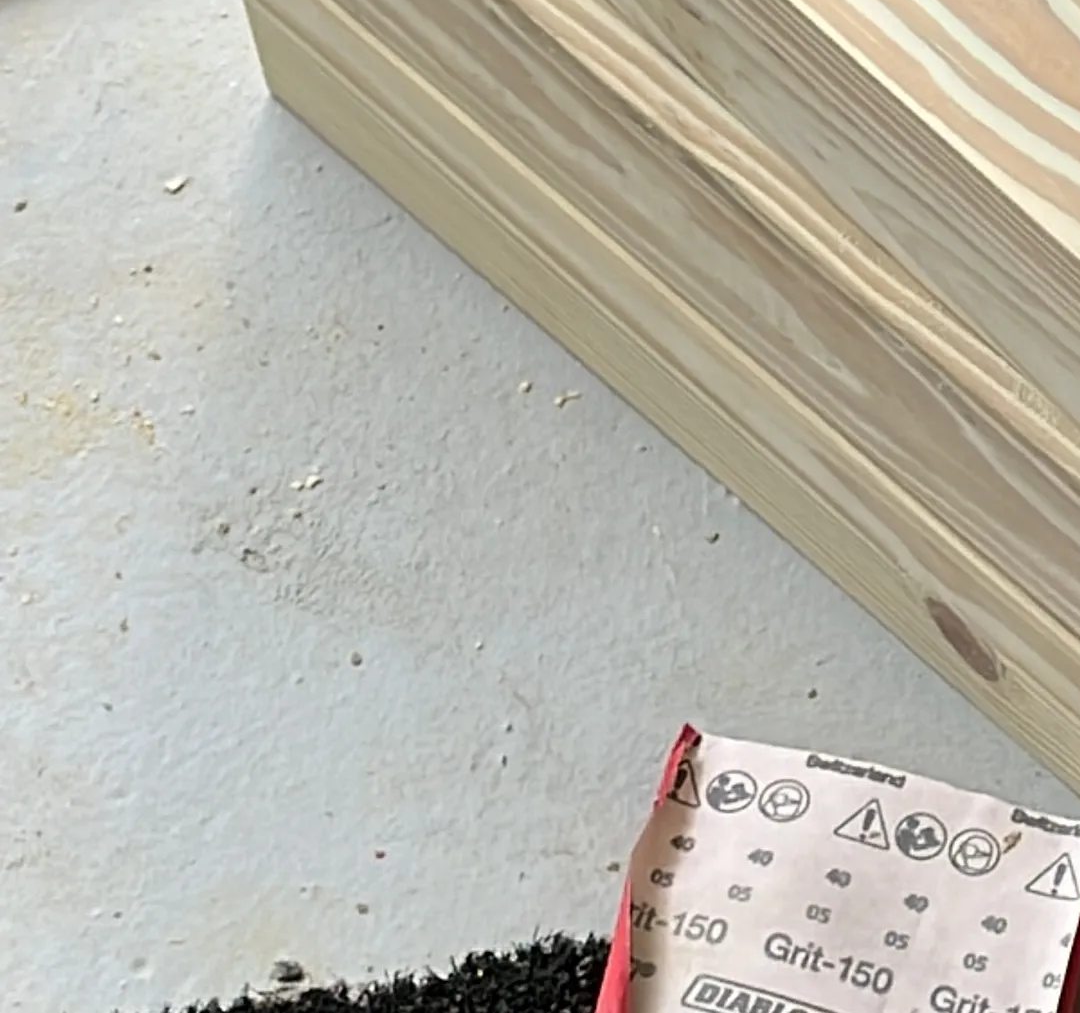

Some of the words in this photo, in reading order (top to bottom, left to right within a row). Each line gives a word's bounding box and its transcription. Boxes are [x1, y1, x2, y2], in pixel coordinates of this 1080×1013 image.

[650, 868, 675, 888] 05
[728, 884, 753, 902] 05
[805, 904, 832, 924] 05
[883, 930, 911, 951] 05
[963, 953, 989, 973] 05
[671, 835, 696, 852] 40
[747, 848, 774, 867] 40
[825, 868, 852, 888] 40
[903, 893, 929, 914] 40
[981, 915, 1008, 934] 40
[631, 902, 729, 946] rit-150
[764, 932, 894, 996] Grit-150
[694, 982, 809, 1013] DIABL
